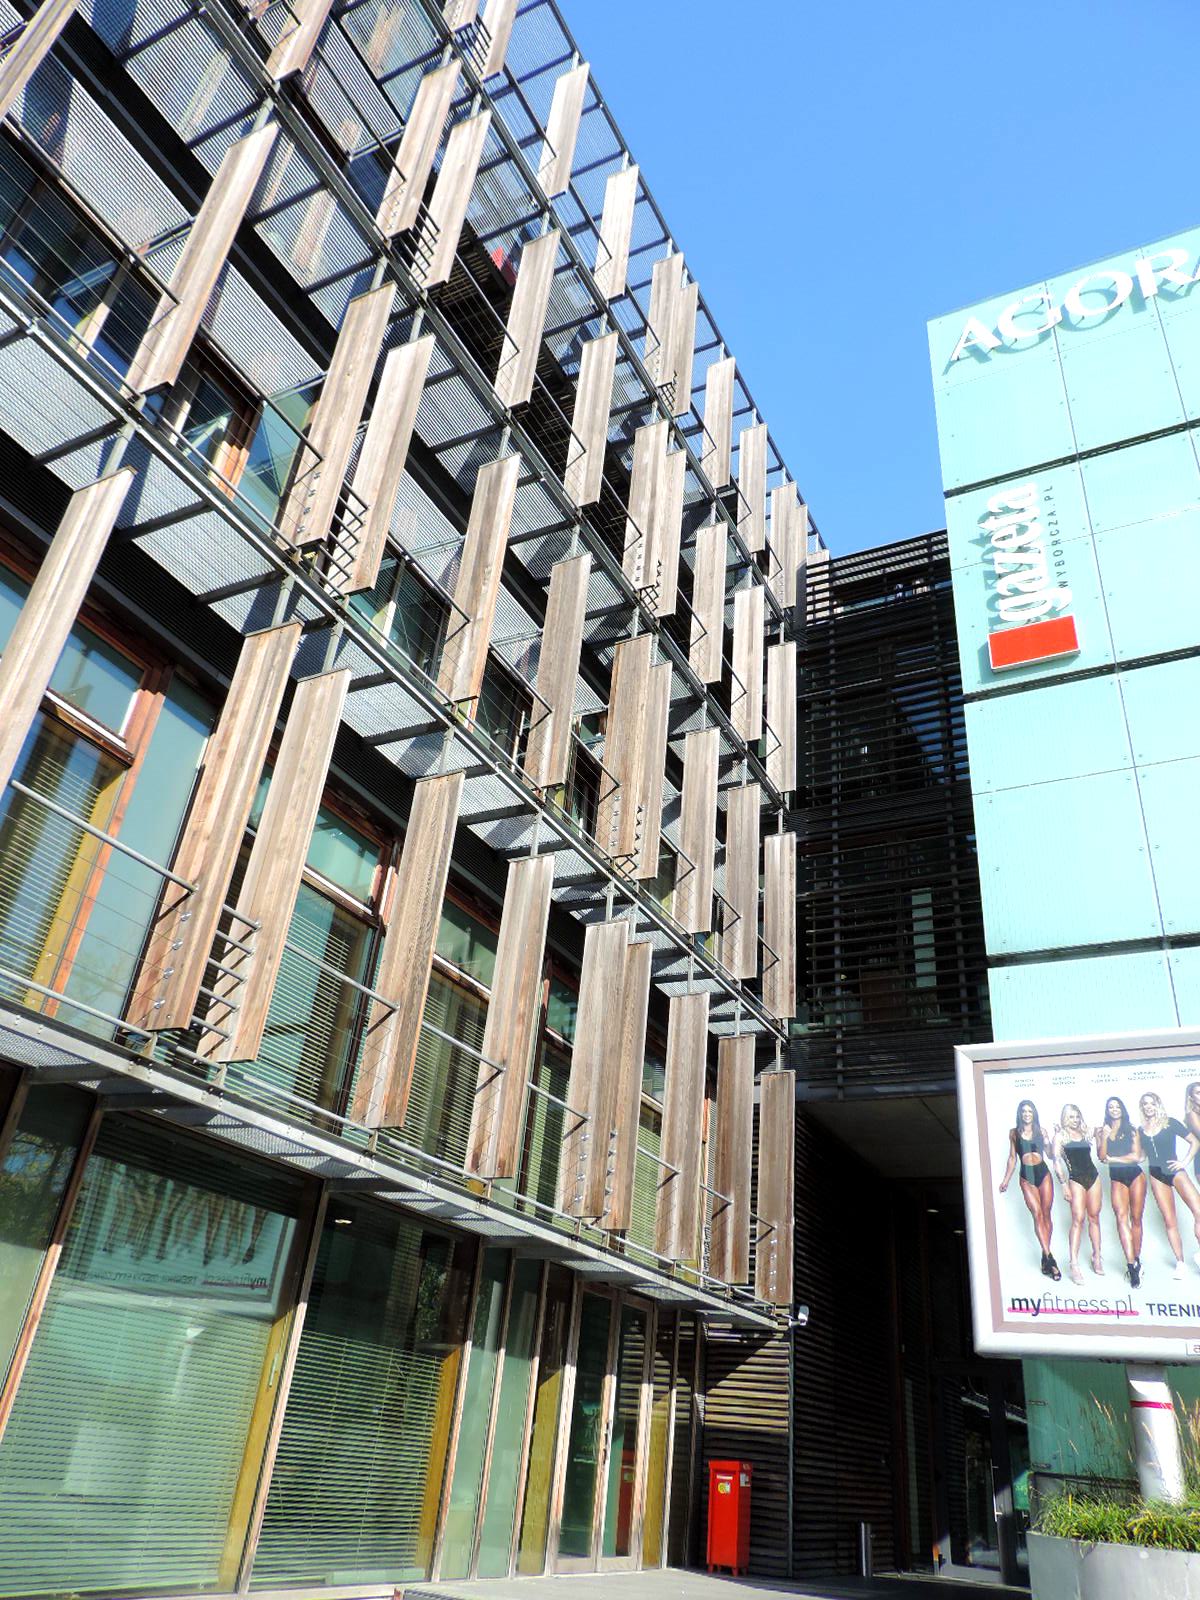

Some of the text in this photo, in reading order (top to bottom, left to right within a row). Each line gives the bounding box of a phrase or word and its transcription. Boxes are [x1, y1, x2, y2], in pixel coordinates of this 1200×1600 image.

[951, 248, 1200, 361] AGOR
[979, 483, 1072, 622] gazeta
[1043, 485, 1069, 588] WYBORCZA.PL
[1010, 1291, 1135, 1319] myfitness.pl
